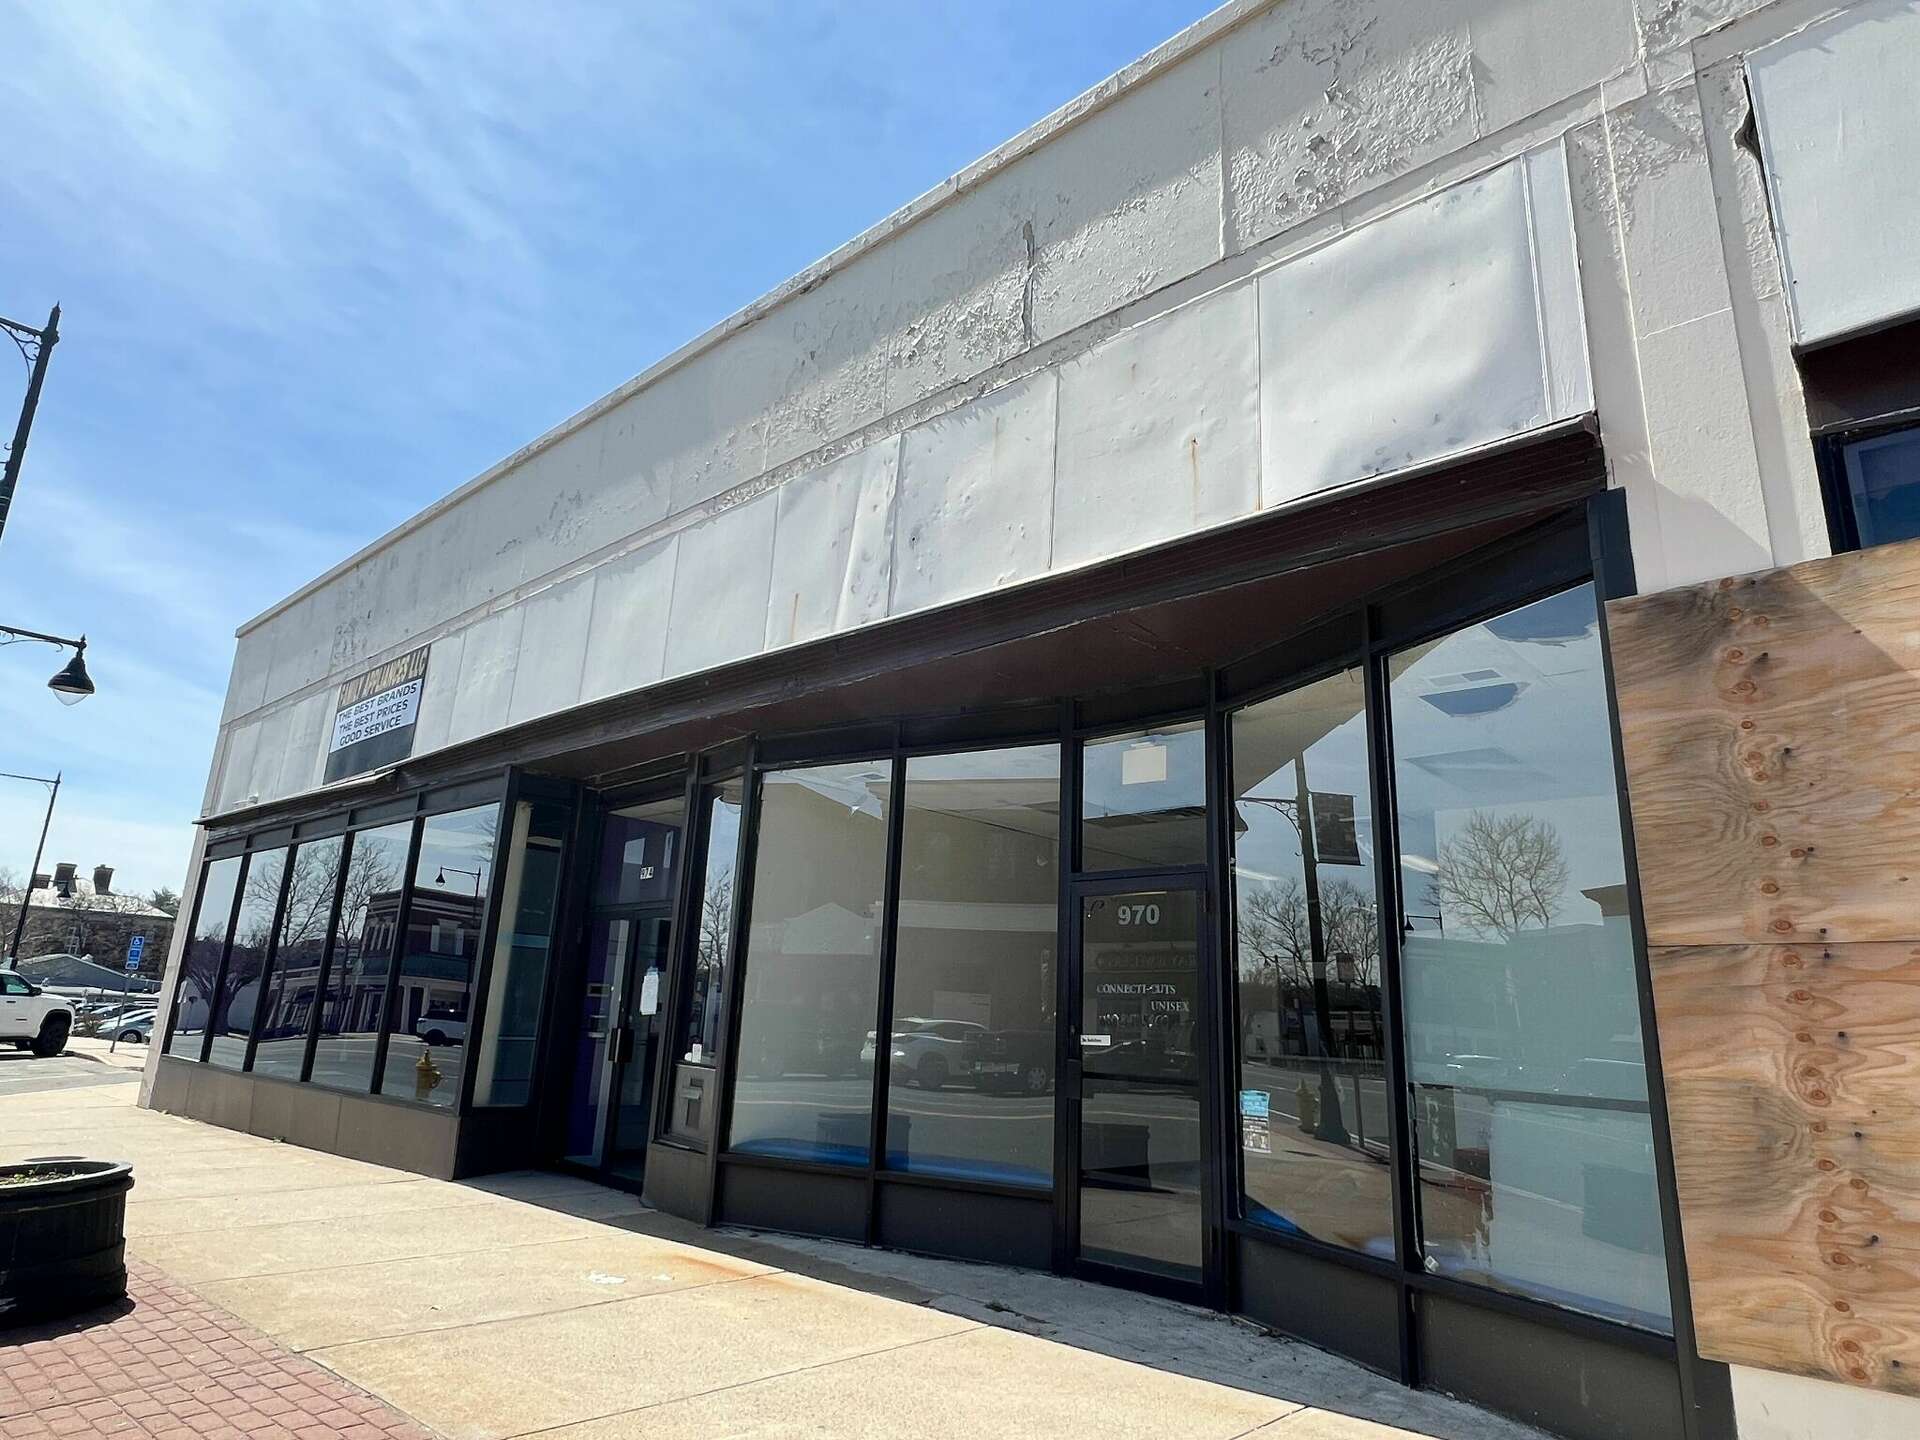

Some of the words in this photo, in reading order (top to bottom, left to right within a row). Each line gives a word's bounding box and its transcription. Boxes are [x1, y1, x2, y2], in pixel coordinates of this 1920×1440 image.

[339, 708, 353, 722] THE
[354, 699, 376, 715] BEST
[378, 683, 417, 706] BRANDS
[340, 720, 353, 734] THE
[354, 711, 375, 728] BEST
[377, 699, 409, 719] PRICES
[340, 730, 362, 746] GOOD
[364, 715, 402, 737] SERVICE
[1117, 904, 1160, 925] 970
[1151, 1001, 1190, 1012] UNISEX
